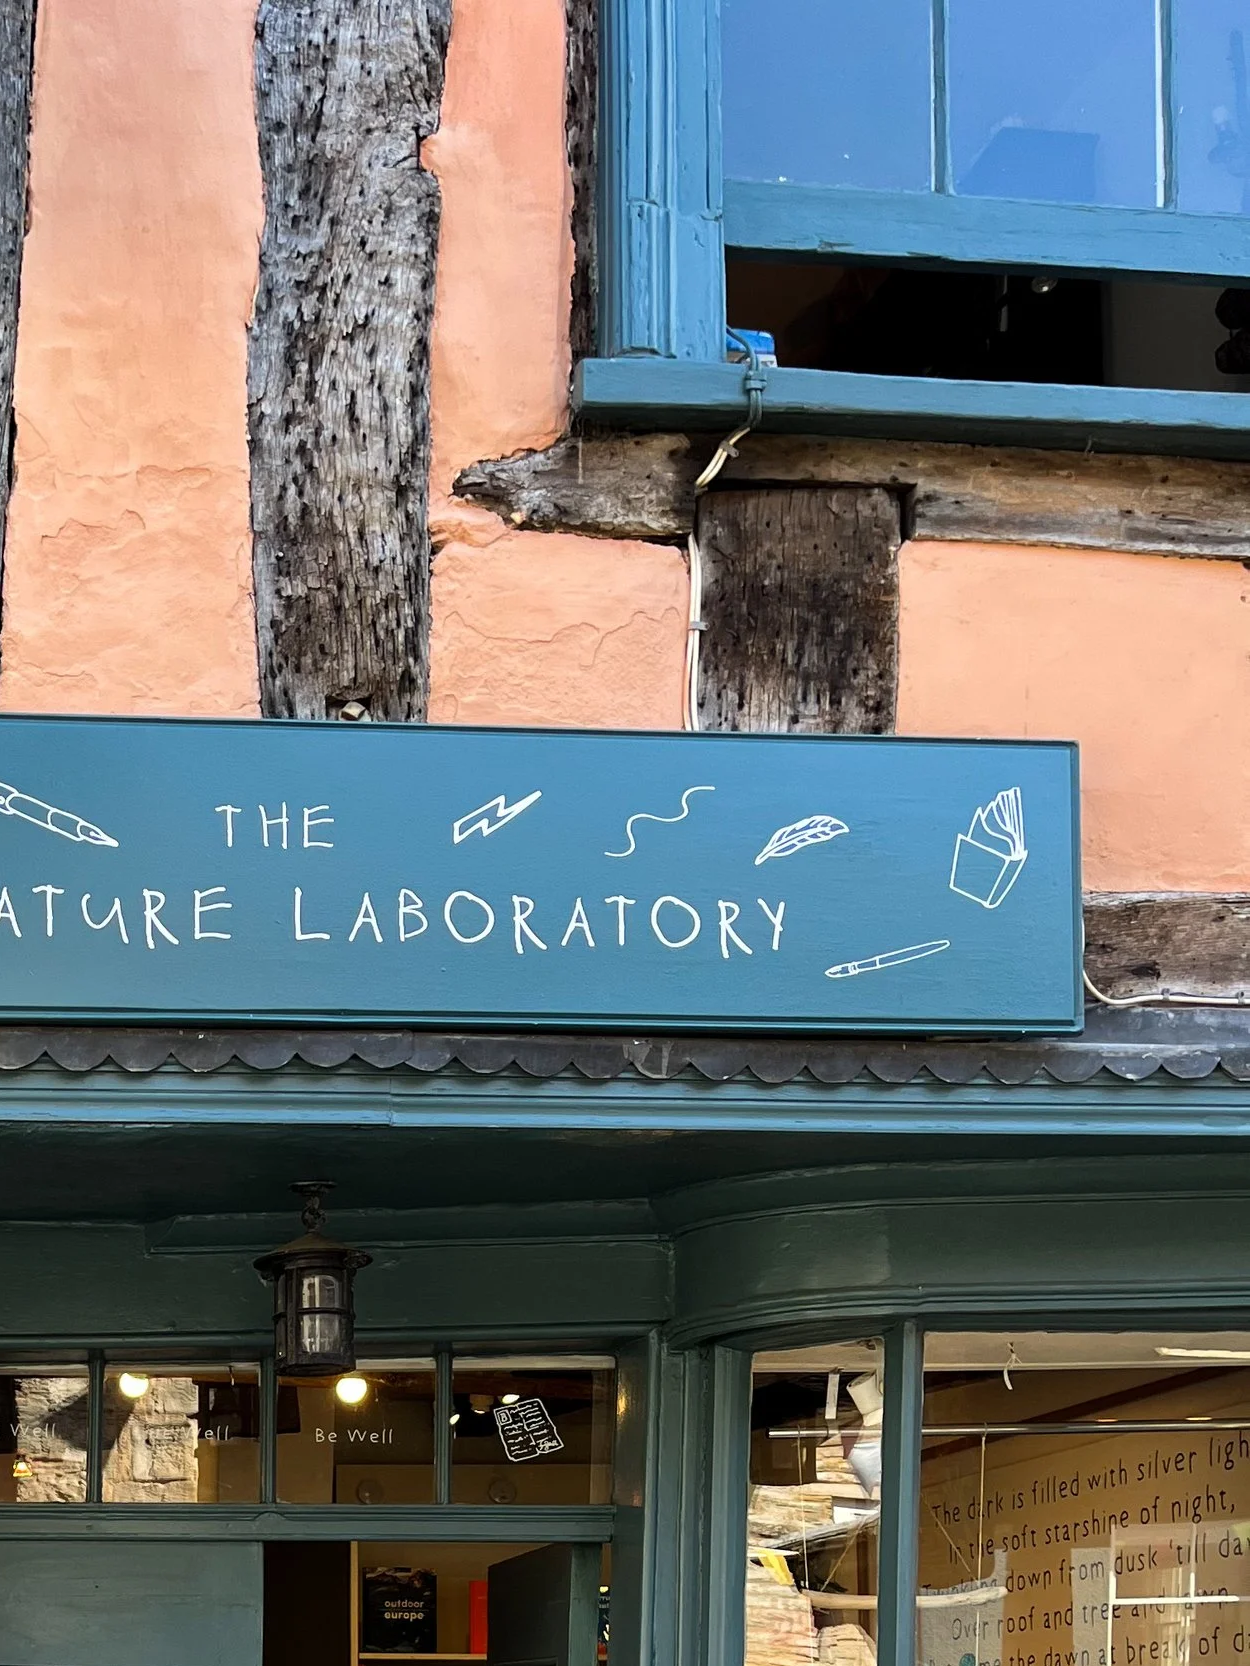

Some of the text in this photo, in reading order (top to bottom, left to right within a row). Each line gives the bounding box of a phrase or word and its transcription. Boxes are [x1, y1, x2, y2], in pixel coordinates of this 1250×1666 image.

[215, 801, 335, 850] THE
[293, 886, 787, 960] LABORATORY
[11, 1422, 58, 1439] Well
[314, 1427, 395, 1445] Be Well
[931, 1501, 960, 1528] The
[967, 1490, 1004, 1520] dark
[1012, 1487, 1024, 1510] is
[1031, 1471, 1080, 1505] filled
[1086, 1458, 1128, 1490] with
[1136, 1449, 1198, 1481] silver
[950, 1483, 1235, 1565] In the soft starshine of night,
[1005, 1568, 1052, 1593] down
[1058, 1558, 1105, 1583] from
[1114, 1544, 1158, 1575] dusk
[1169, 1532, 1207, 1564] 'till
[384, 1599, 425, 1609] outdoor
[384, 1611, 425, 1622] europe
[951, 1618, 990, 1641] Over
[997, 1605, 1035, 1638] roof
[1043, 1601, 1074, 1631] and
[1082, 1601, 1121, 1626] tree
[1098, 1645, 1116, 1666] at
[1125, 1631, 1188, 1666] break
[1198, 1626, 1220, 1656] of
